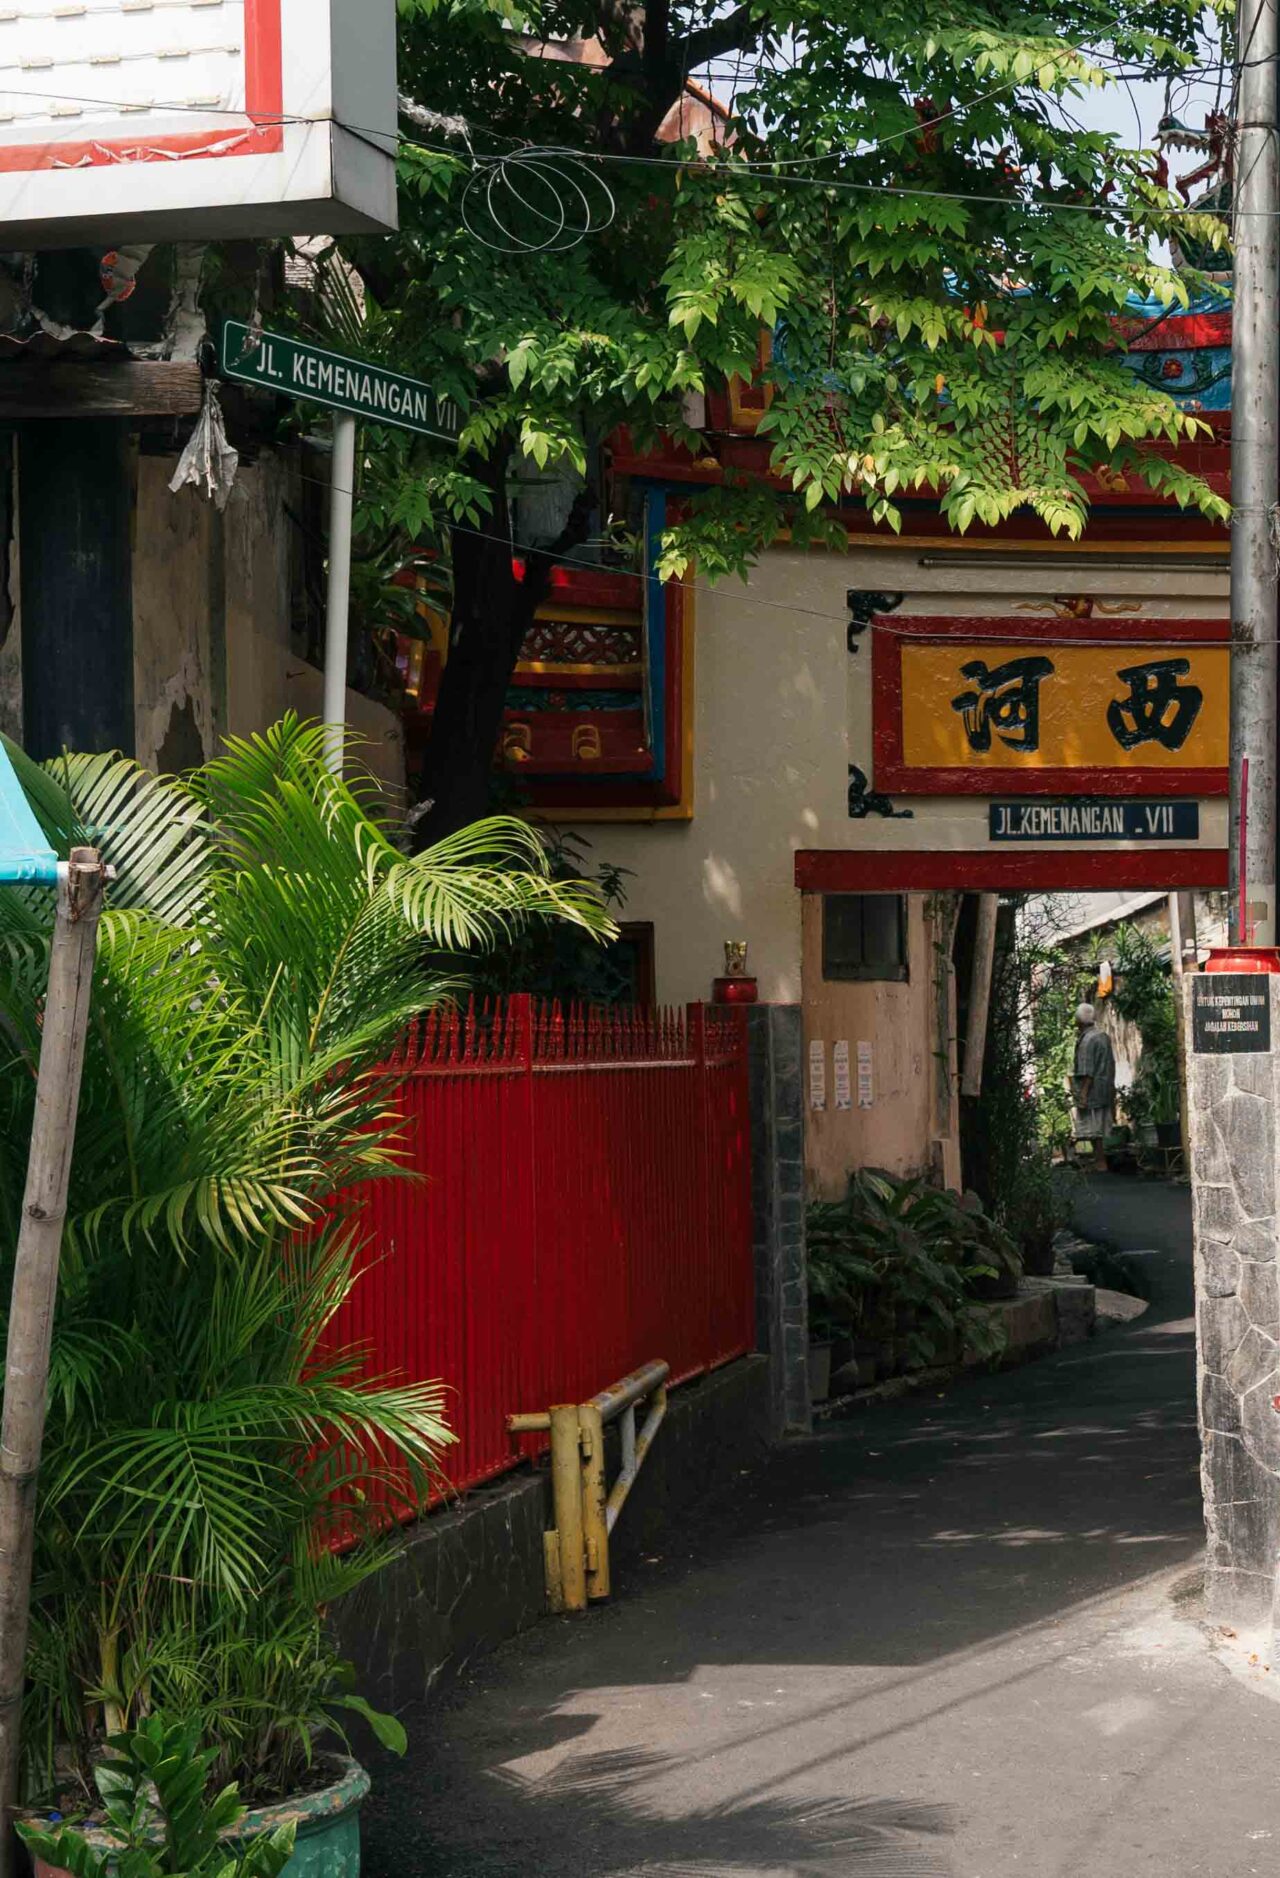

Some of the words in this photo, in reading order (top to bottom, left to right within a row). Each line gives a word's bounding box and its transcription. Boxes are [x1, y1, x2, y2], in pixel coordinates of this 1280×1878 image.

[256, 342, 284, 379] JL.
[292, 352, 428, 422] KEMENANGAN
[435, 401, 457, 431] VII
